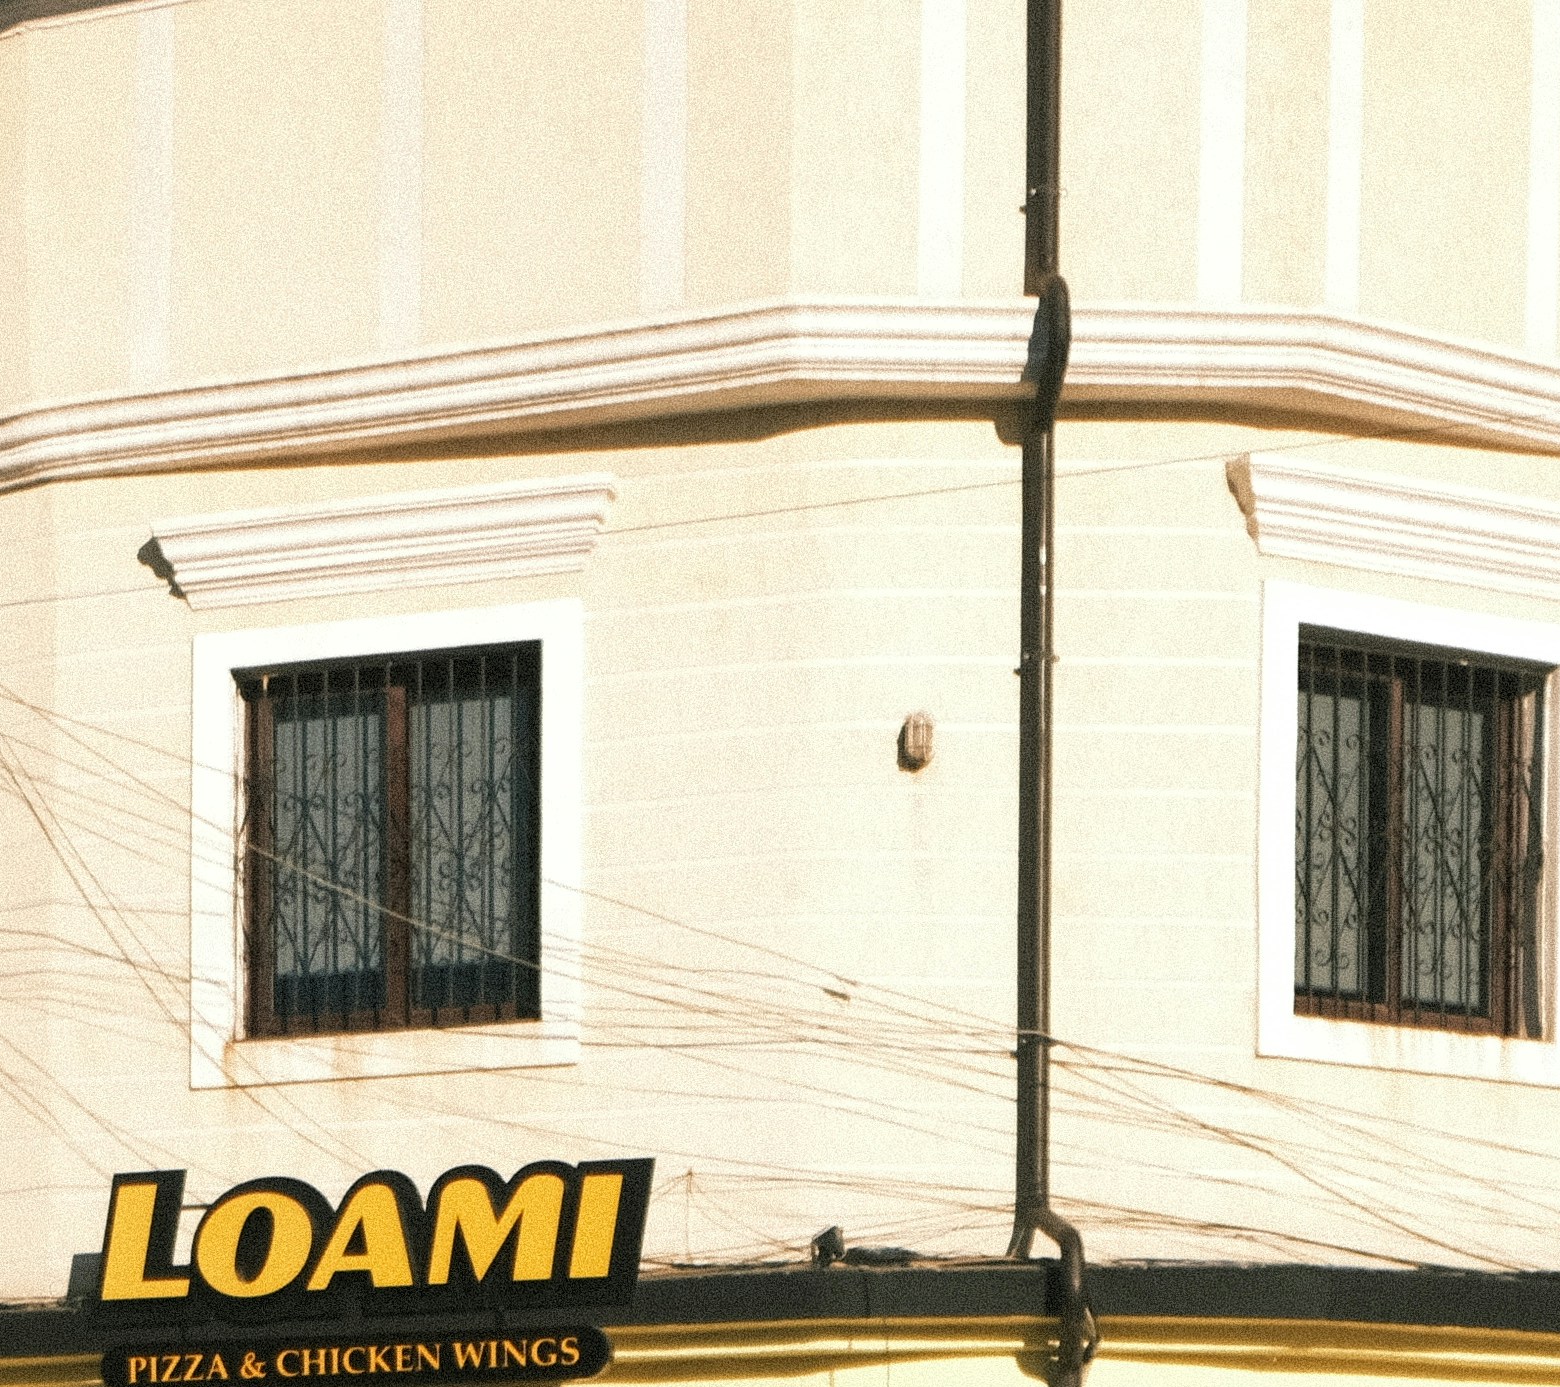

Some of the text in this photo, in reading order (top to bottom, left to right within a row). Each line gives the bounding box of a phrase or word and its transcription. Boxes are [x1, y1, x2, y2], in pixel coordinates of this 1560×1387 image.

[101, 1173, 624, 1301] LOAMI
[127, 1337, 581, 1384] PIZZA & CHICKEN WINGS
